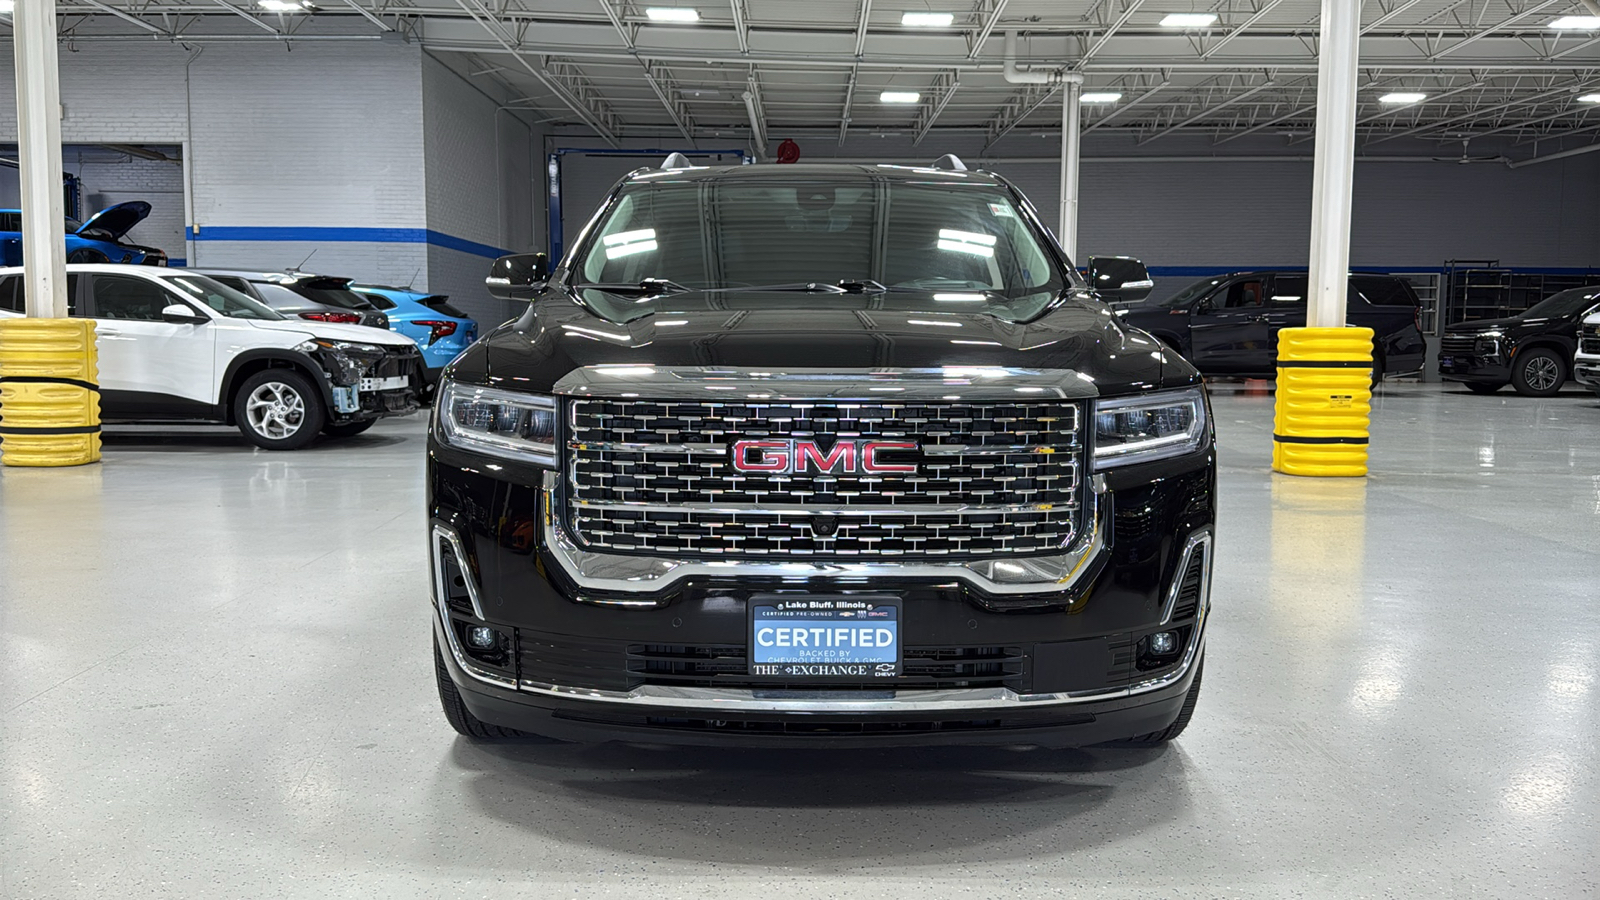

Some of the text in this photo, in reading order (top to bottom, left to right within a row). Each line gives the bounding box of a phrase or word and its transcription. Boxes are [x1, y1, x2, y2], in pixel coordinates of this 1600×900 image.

[732, 439, 919, 474] GMC
[785, 601, 866, 610] Lake Bluff, Illinois
[757, 627, 894, 647] CERTIFIED
[753, 665, 867, 675] THE EXCHANGE
